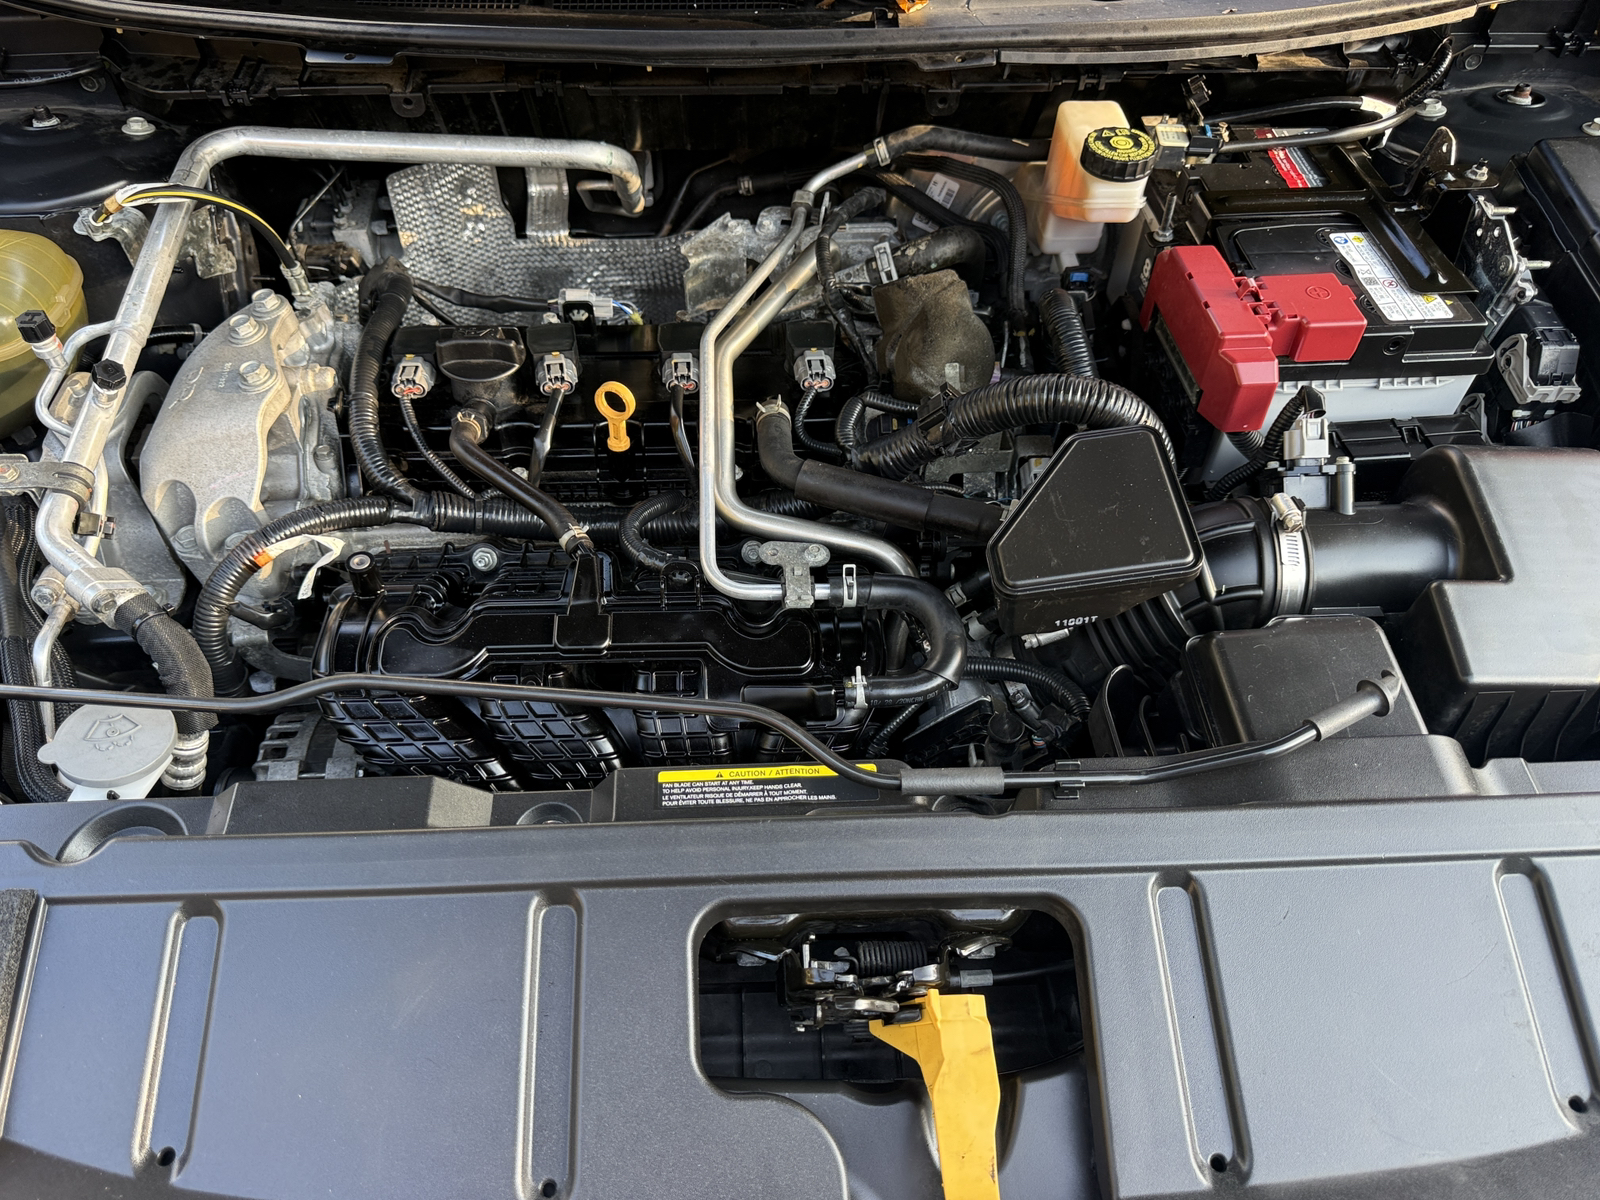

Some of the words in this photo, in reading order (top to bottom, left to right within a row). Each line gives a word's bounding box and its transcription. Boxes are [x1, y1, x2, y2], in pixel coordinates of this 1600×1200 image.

[728, 769, 766, 778] CAUTION
[775, 768, 820, 776] ATTENTION
[773, 794, 807, 802] APPROCHER
